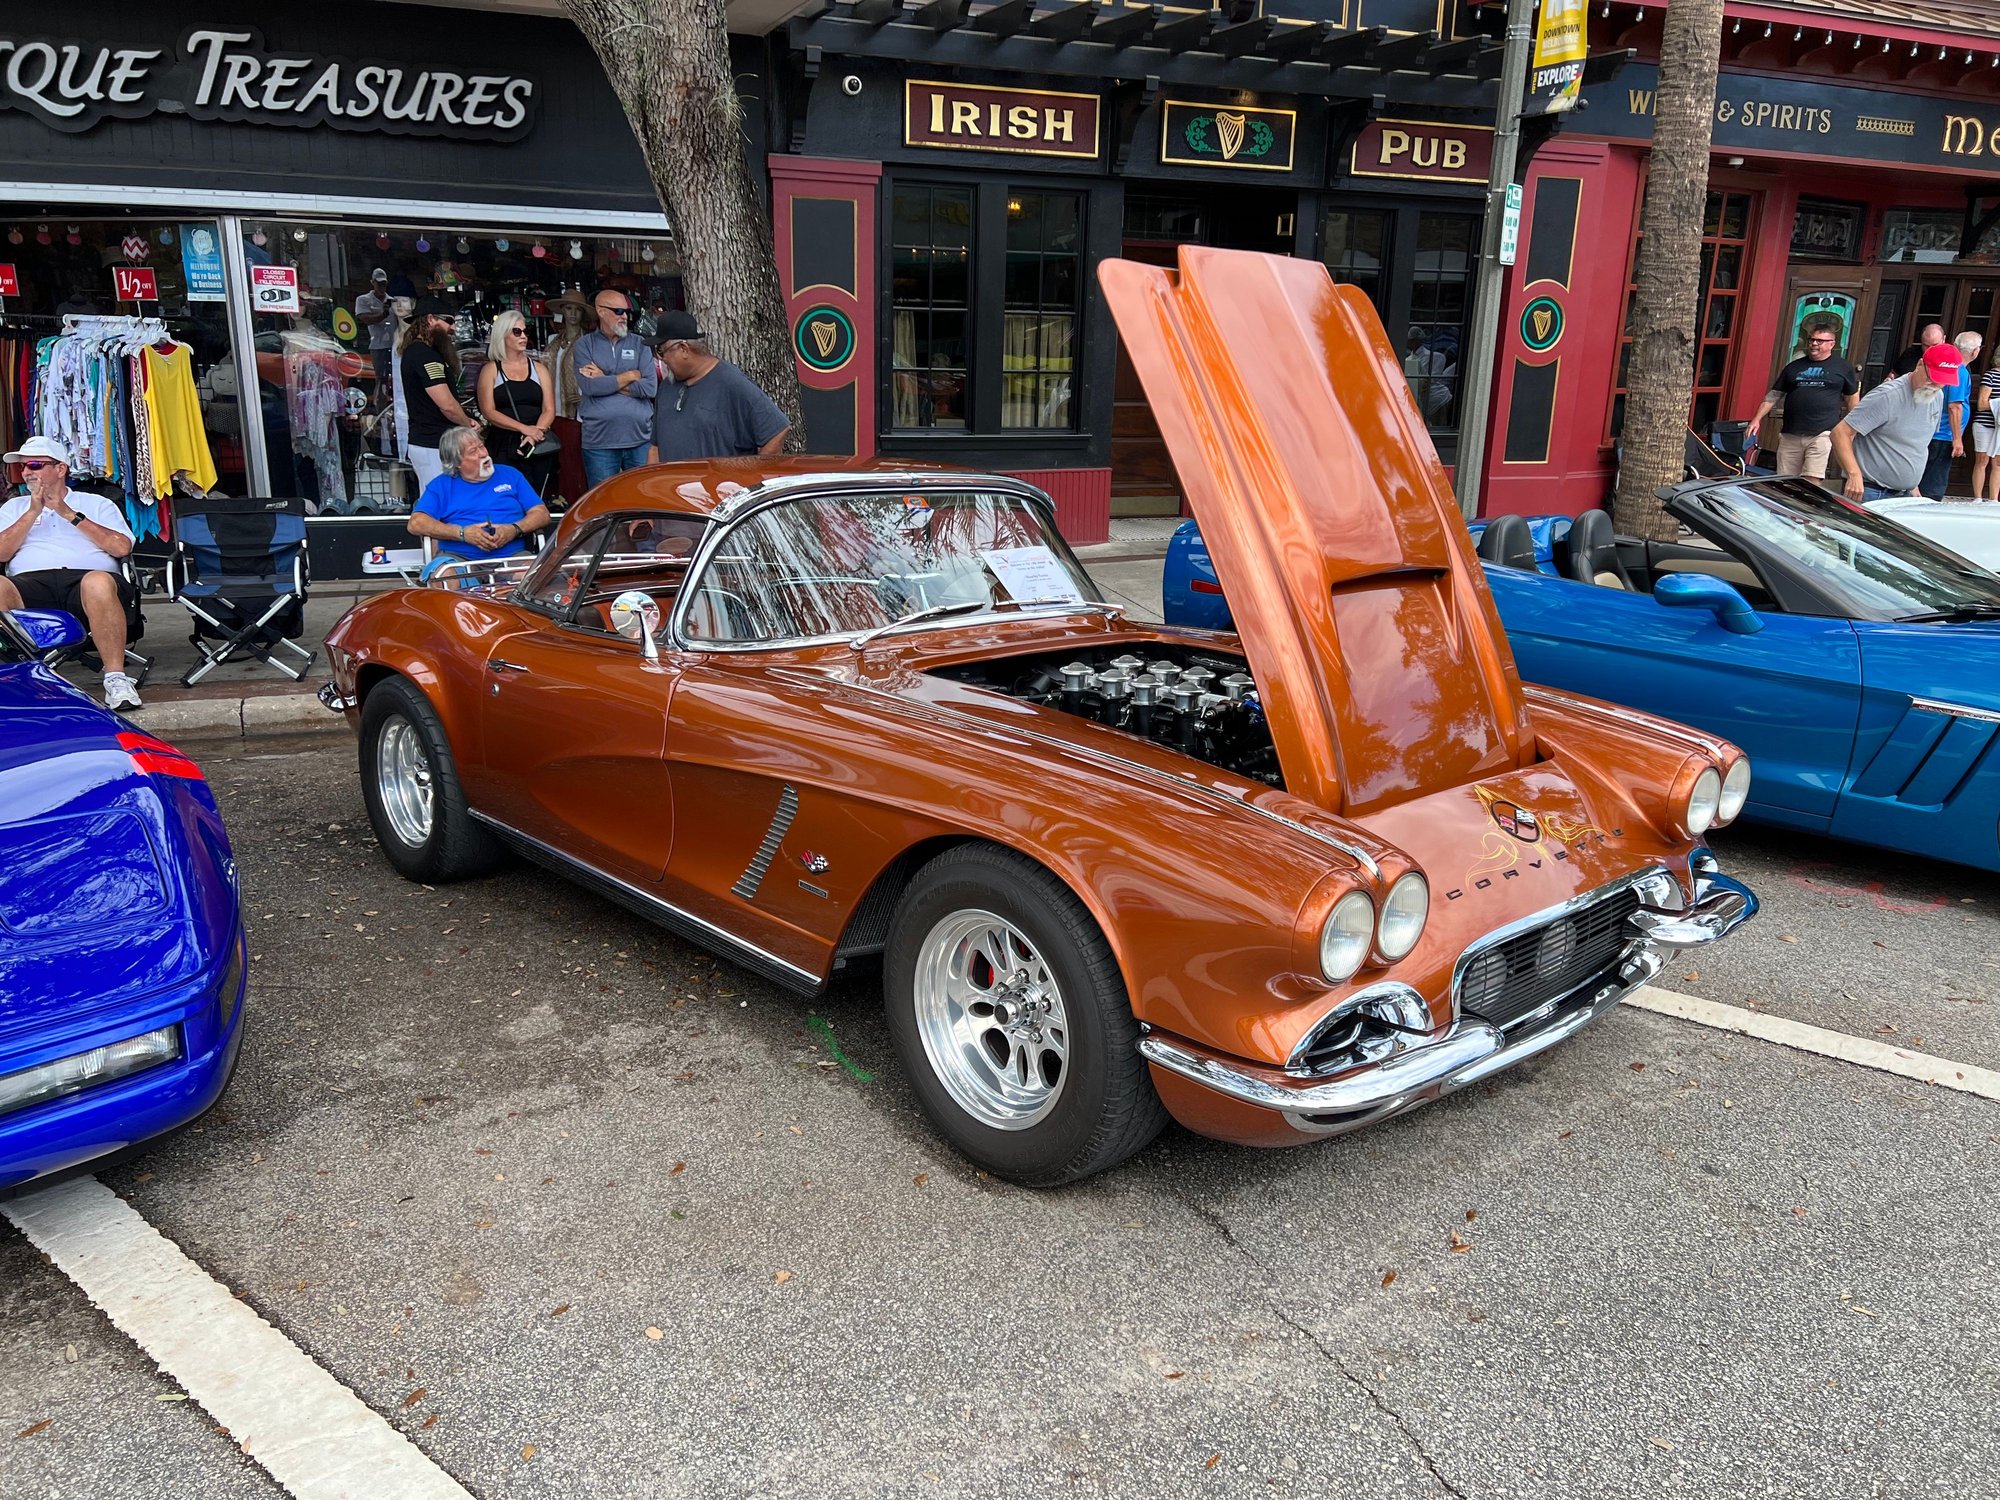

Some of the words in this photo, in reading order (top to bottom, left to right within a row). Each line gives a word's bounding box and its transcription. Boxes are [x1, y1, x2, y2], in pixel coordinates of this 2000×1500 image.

[1543, 23, 1581, 39] DOWNTOWN
[0, 41, 162, 117] QUE
[187, 30, 533, 129] TREASURES
[1537, 64, 1580, 88] EXPLORE
[930, 93, 1074, 142] IRISH
[1717, 100, 1735, 122] &
[1741, 101, 1832, 134] SPIRITS
[1380, 129, 1466, 169] PUB
[1507, 188, 1513, 206] 3
[120, 271, 143, 298] 1/2
[1446, 828, 1624, 901] CORVETTE
